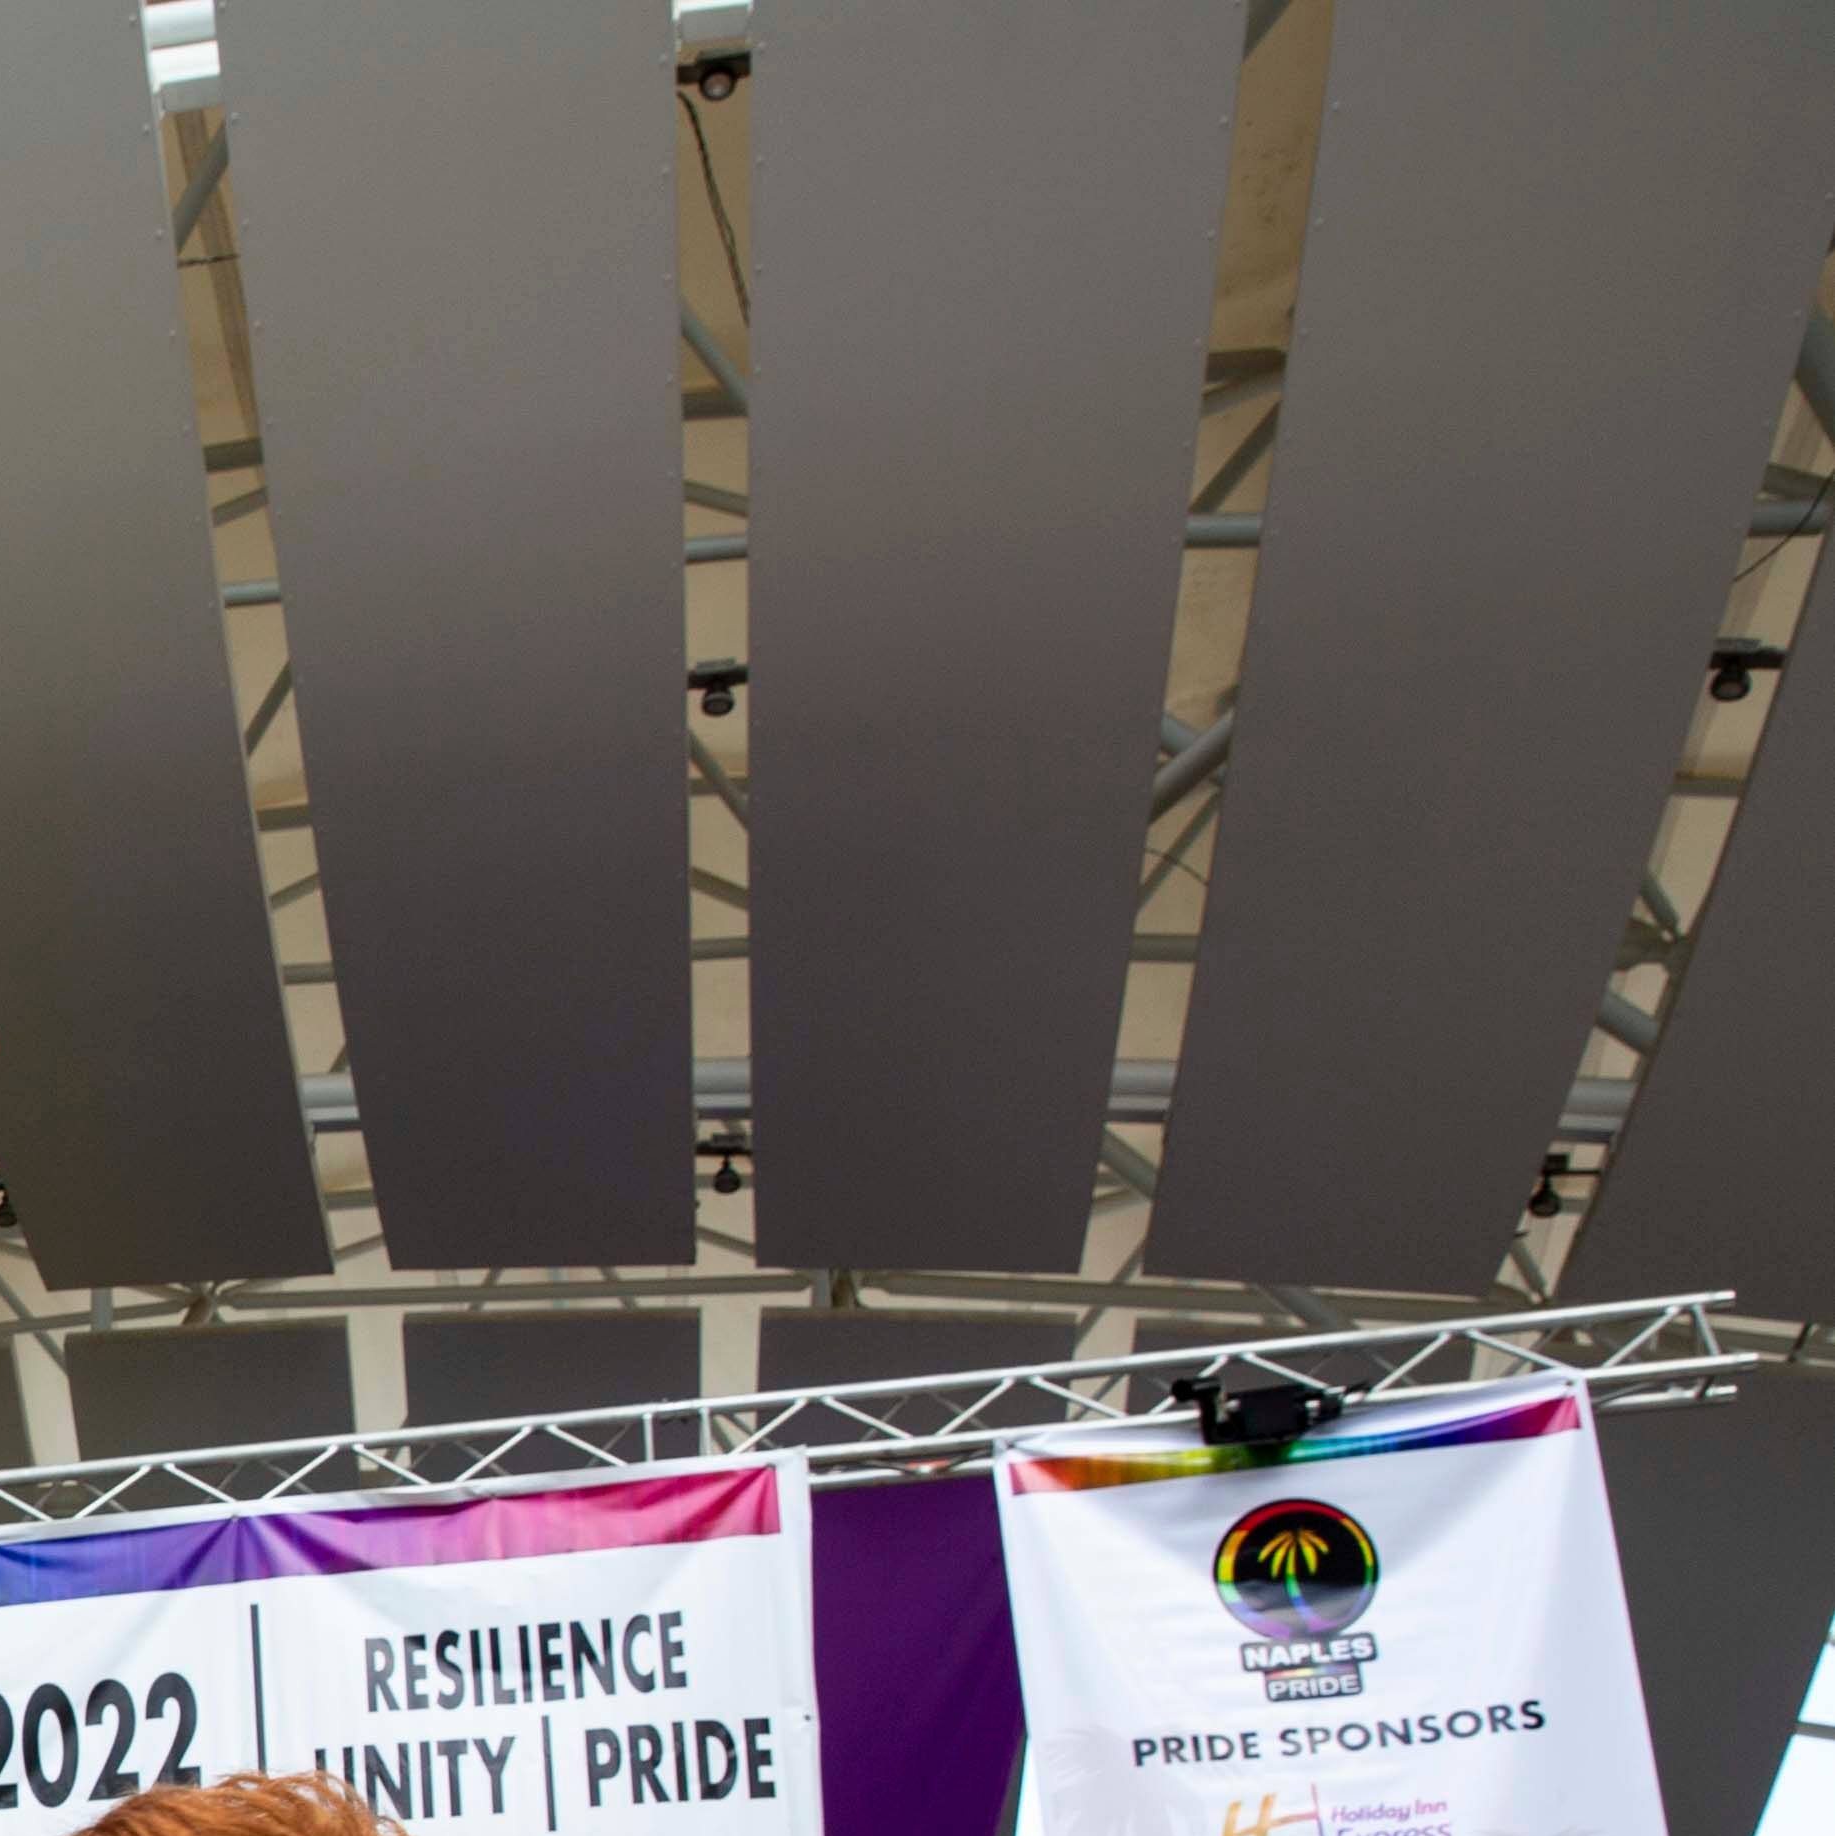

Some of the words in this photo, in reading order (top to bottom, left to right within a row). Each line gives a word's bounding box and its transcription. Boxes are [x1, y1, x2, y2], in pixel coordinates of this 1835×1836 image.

[365, 1611, 689, 1713] RESILIENCE
[1243, 1638, 1374, 1670] NAPLES
[1267, 1674, 1362, 1700] PRIDE
[1132, 1731, 1261, 1767] PRIDE
[1278, 1699, 1547, 1758] SPONSORS
[584, 1717, 778, 1808] PRIDE
[1331, 1804, 1411, 1823] Holiday
[1415, 1798, 1448, 1816] Inn
